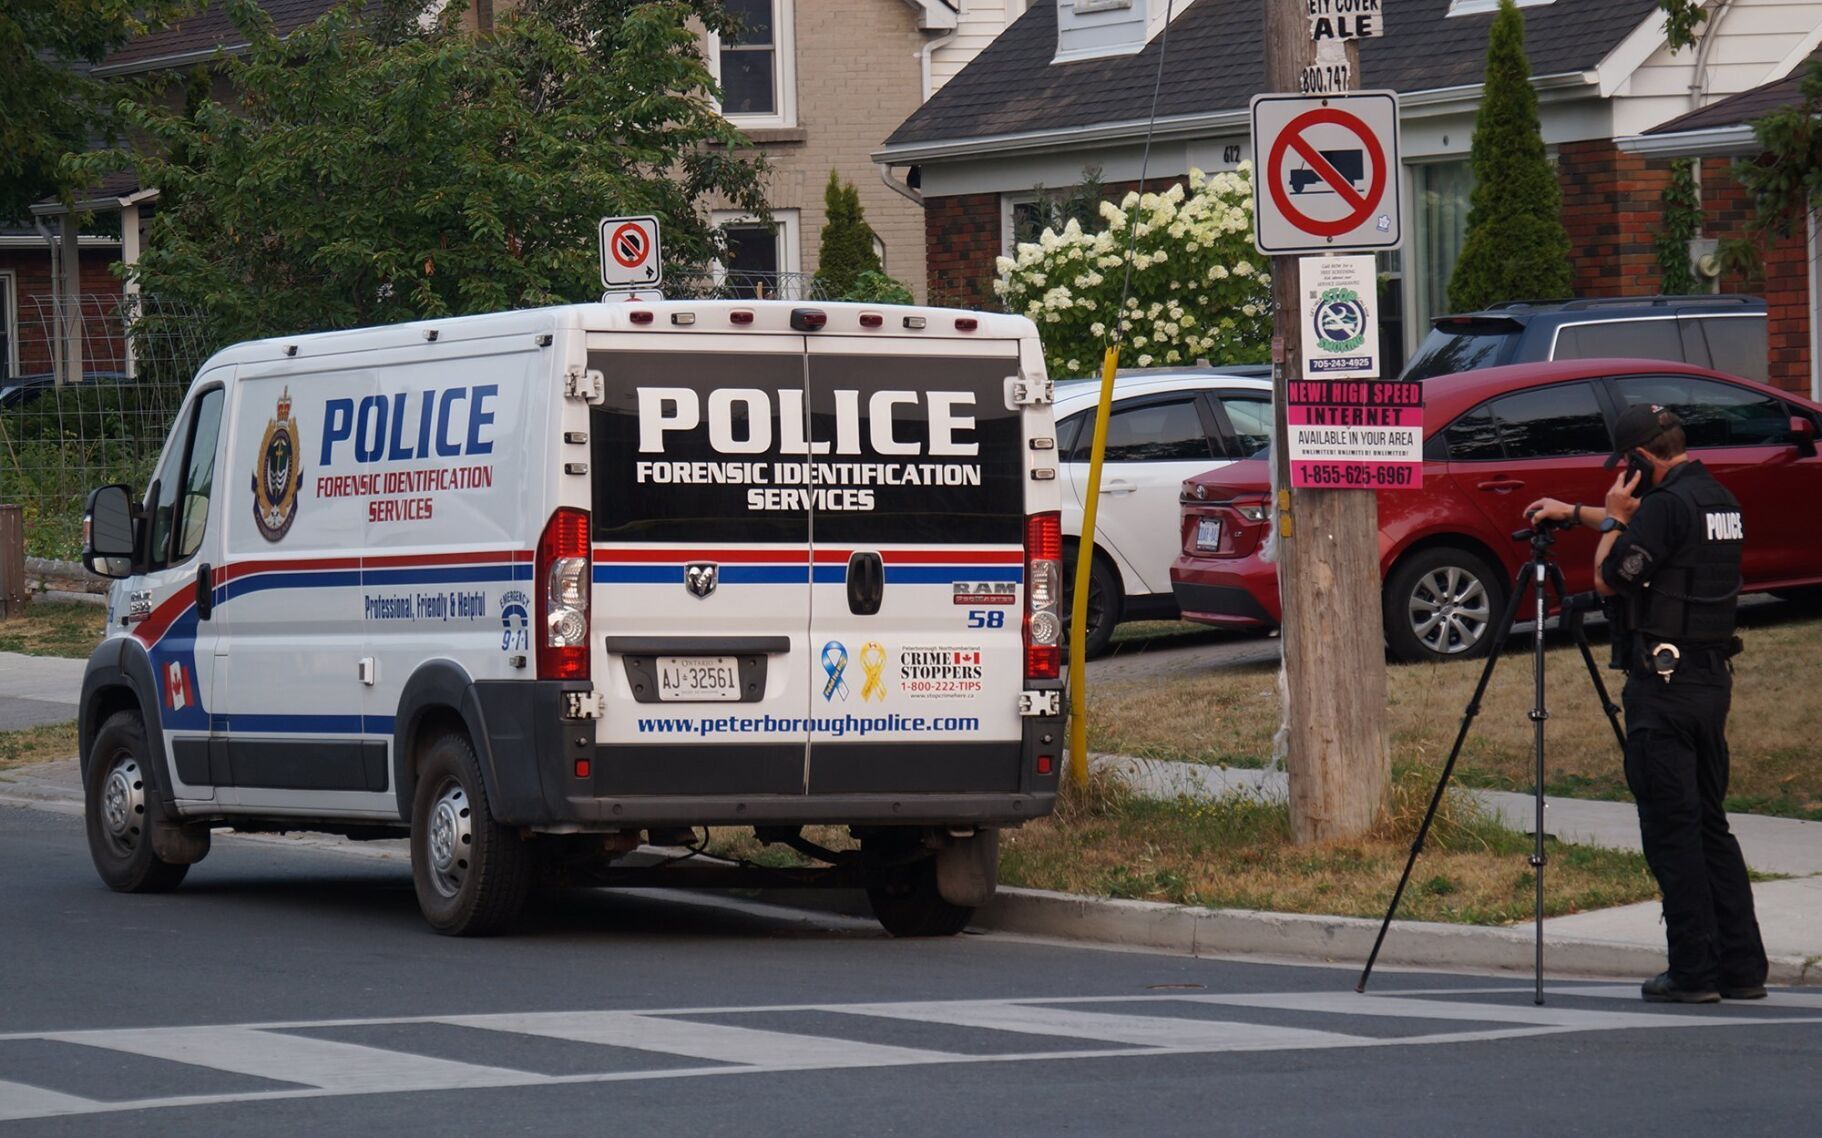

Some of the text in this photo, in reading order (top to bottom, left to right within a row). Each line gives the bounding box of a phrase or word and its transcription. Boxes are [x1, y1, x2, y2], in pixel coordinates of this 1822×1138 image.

[1223, 145, 1241, 163] 612
[1316, 334, 1366, 353] SMOKING
[1312, 358, 1370, 369] 705-243-4925
[1288, 382, 1420, 404] NEW! HIGH SPEED
[318, 384, 500, 466] POLICE
[636, 387, 981, 457] POLICE
[1306, 407, 1403, 425] INTERNET
[1298, 430, 1414, 446] AVAILABLE IN YOUR AREA
[316, 465, 493, 498] FORENSIC IDENTIFICATION
[636, 461, 981, 486] FORENSIC IDENTIFICATION
[1300, 465, 1413, 485] 1-855-625-6967
[747, 488, 875, 511] SERVICES
[368, 498, 433, 522] SERVICES
[1706, 512, 1744, 540] POLICE
[953, 583, 1016, 594] RAM
[365, 591, 486, 622] Professional, Friendly & Helpful
[499, 590, 531, 609] EMERGENCY
[967, 610, 1005, 628] 58
[900, 652, 951, 665] CRIME
[663, 667, 735, 689] AJ 32561
[900, 666, 982, 679] STOPPERS
[901, 681, 982, 691] 1-800-222-TIPS
[638, 714, 980, 736] www.peterboroughpolice.com
